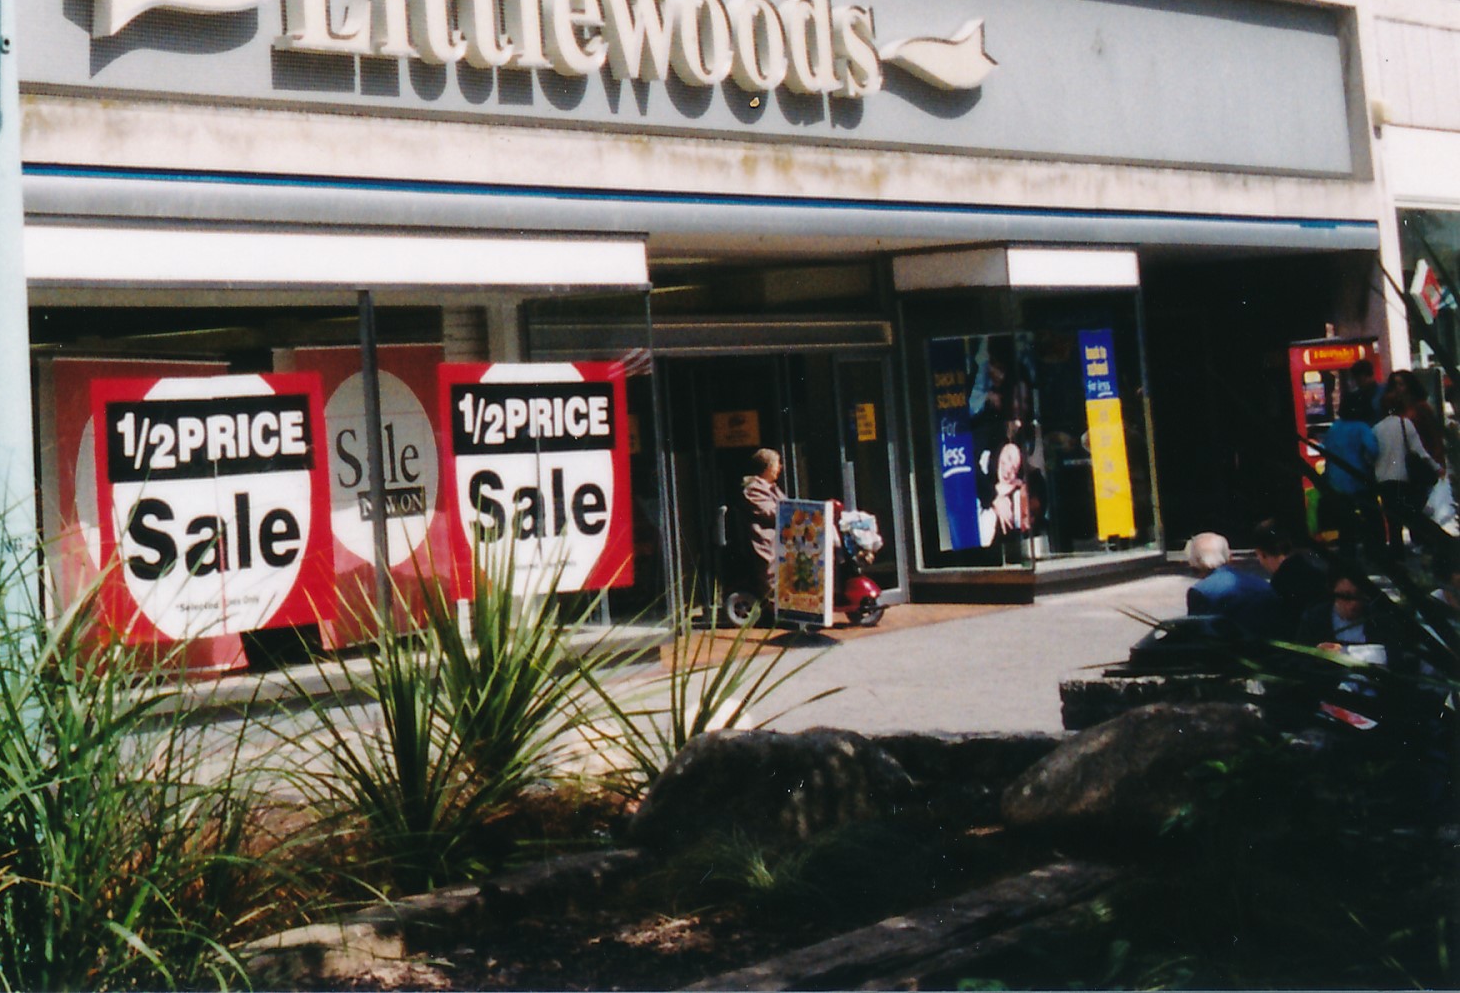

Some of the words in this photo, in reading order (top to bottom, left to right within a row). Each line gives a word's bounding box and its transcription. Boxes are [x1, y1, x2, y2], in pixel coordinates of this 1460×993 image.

[335, 421, 421, 488] Sle
[942, 444, 967, 467] less
[127, 492, 301, 581] Sale
[360, 495, 397, 517] NW
[468, 468, 608, 544] Sale
